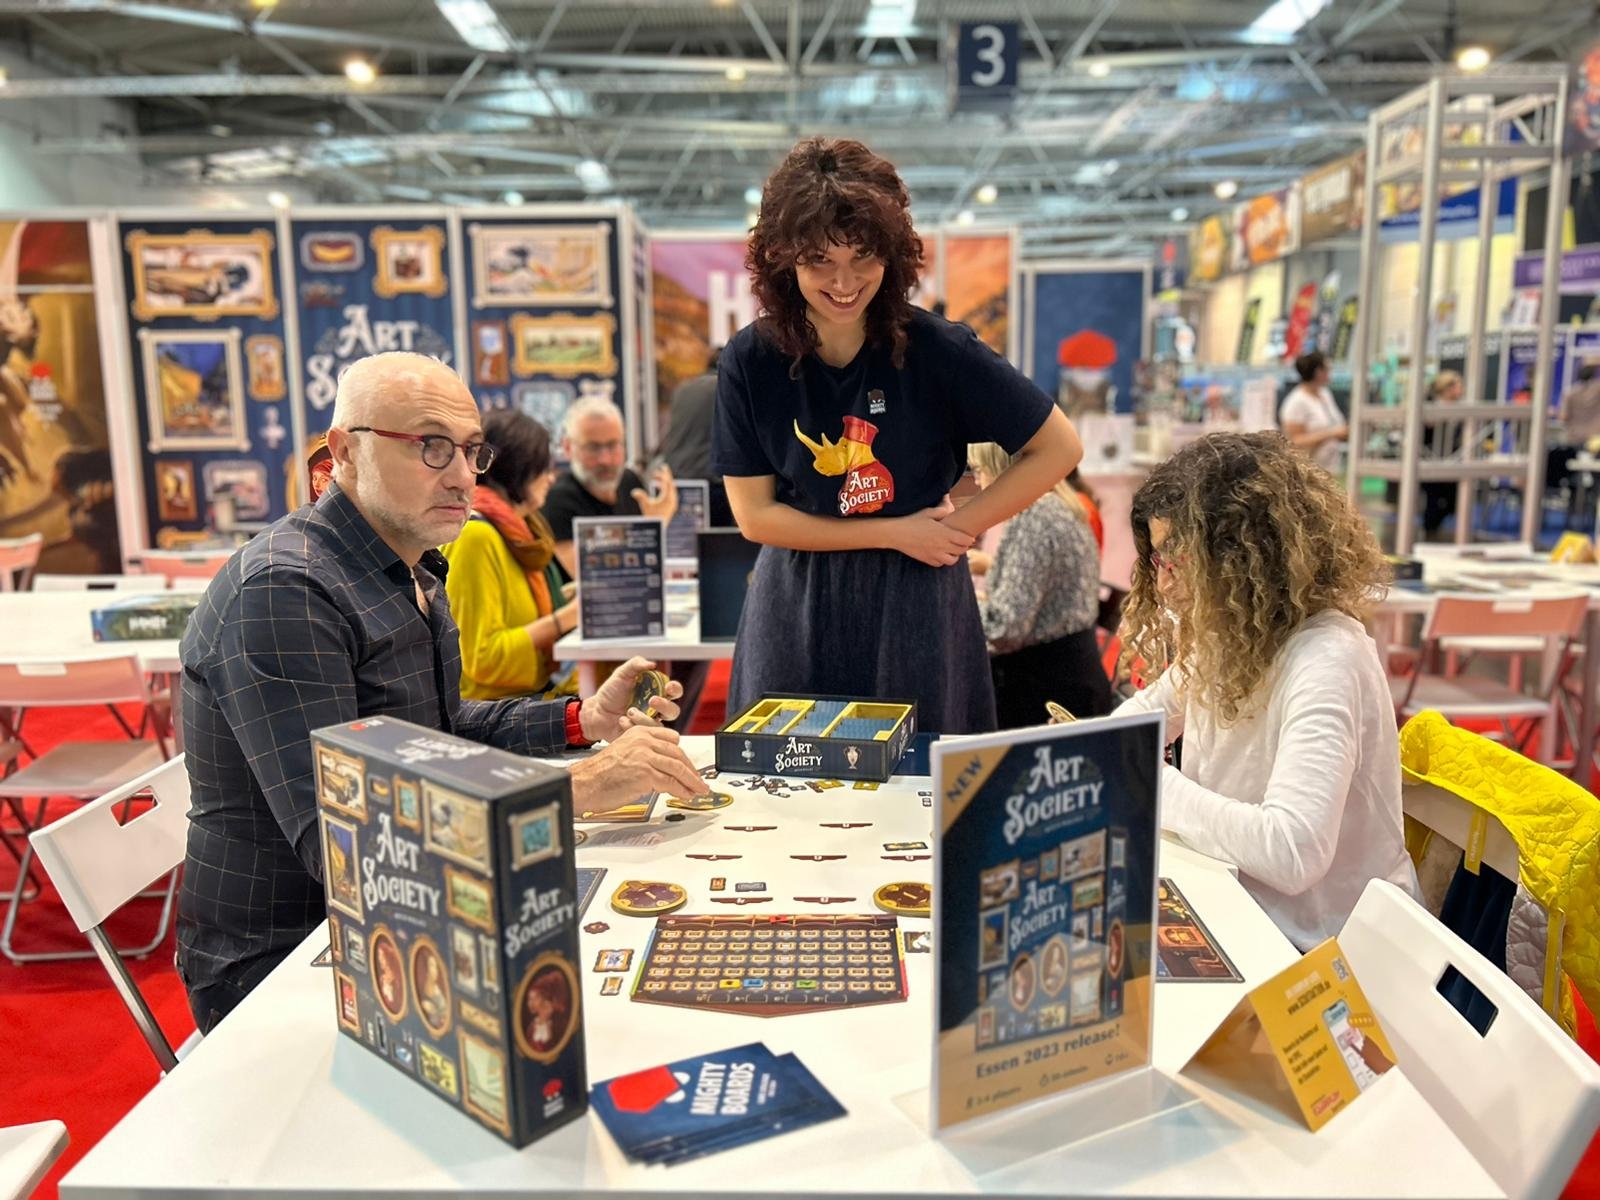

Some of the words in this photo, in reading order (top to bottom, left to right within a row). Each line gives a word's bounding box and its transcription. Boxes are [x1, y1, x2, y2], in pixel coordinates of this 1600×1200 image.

[971, 24, 1005, 87] 3
[335, 303, 420, 358] ART
[840, 487, 890, 514] SOCIETY
[849, 471, 878, 492] ART
[774, 753, 823, 773] SOCIETY
[785, 736, 812, 755] ART
[1026, 745, 1085, 794] ART
[946, 755, 983, 802] NEW
[1003, 781, 1104, 845] SOCIETY
[376, 812, 420, 873] ART
[362, 856, 441, 916] SOCIETY
[520, 886, 561, 922] ART
[1022, 880, 1056, 916] ART
[504, 902, 575, 958] SOCIETY
[1009, 902, 1068, 951] SOCIETY
[976, 1057, 1019, 1079] Essen
[1024, 1043, 1060, 1064] 2023
[1063, 1024, 1121, 1053] release!
[689, 1061, 727, 1115] MIGHTY
[720, 1062, 756, 1115] BOARDS
